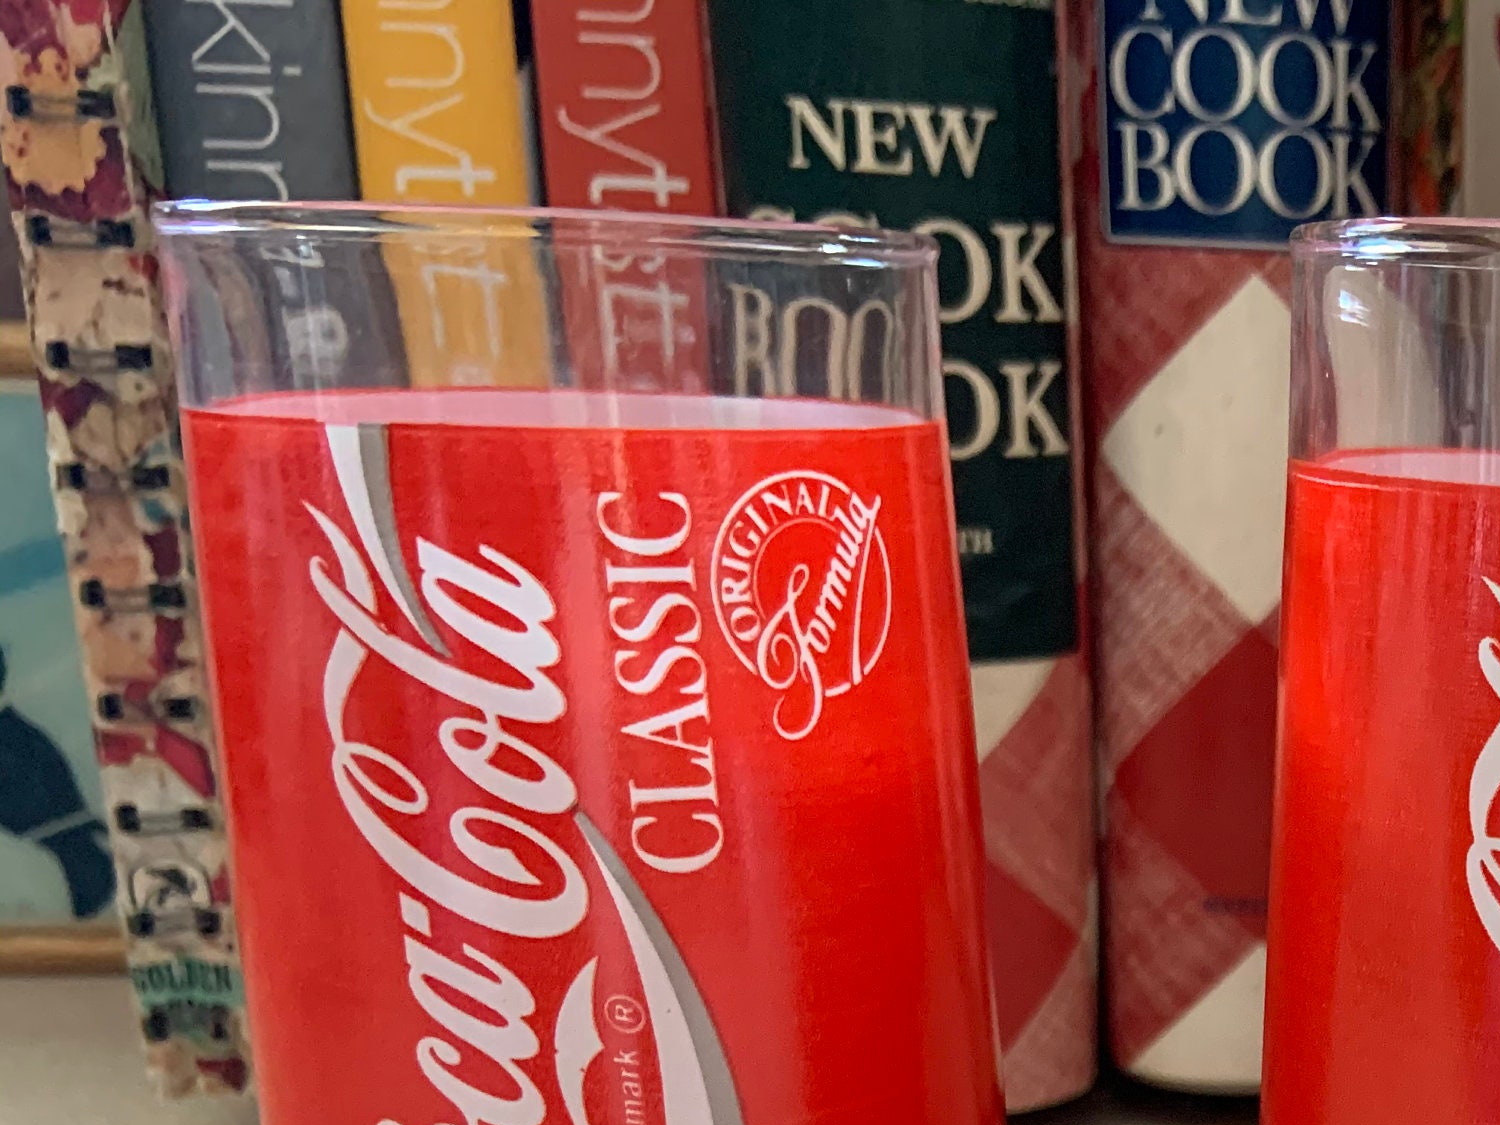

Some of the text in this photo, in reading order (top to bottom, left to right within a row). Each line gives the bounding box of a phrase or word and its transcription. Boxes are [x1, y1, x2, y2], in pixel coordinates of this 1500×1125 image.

[784, 96, 997, 180] NEW
[1109, 27, 1381, 130] COOK
[1117, 120, 1380, 220] BOOK
[720, 482, 838, 642] ORIGINAL
[757, 491, 882, 741] Formula
[597, 491, 725, 874] CLASSIC
